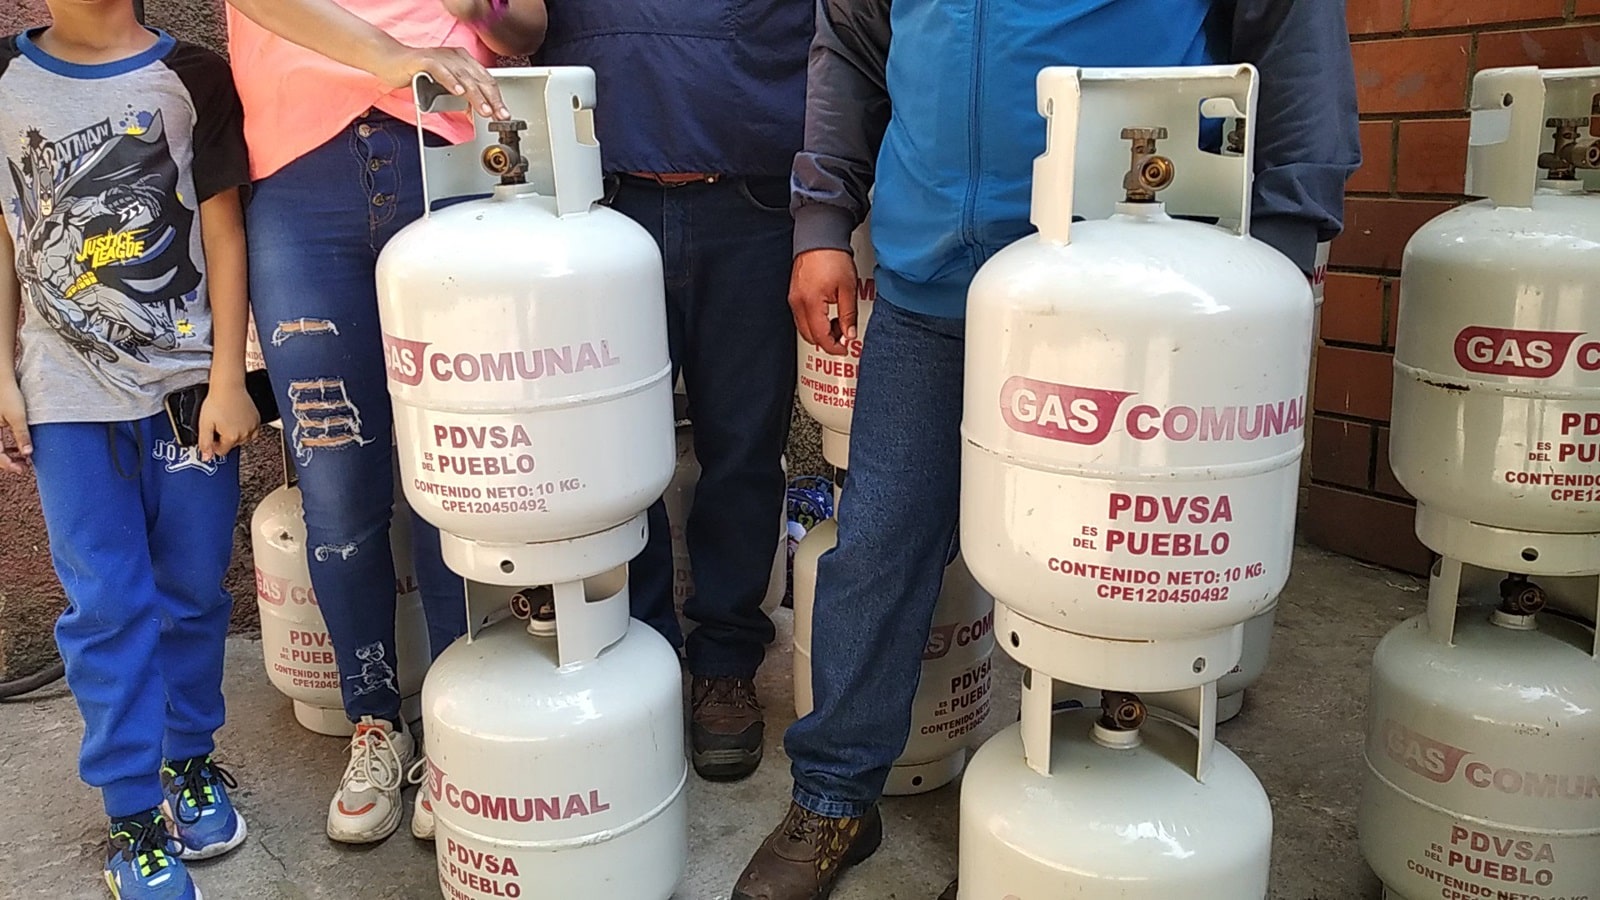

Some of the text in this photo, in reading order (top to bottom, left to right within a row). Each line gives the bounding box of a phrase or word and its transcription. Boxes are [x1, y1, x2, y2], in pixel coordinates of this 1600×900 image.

[76, 230, 138, 262] JUSTICE
[92, 241, 145, 269] LEAGUE
[430, 340, 620, 382] COMUNAL
[1466, 336, 1552, 368] GAS
[801, 376, 839, 395] CONTENIDO
[1011, 388, 1304, 442] GAS COMUNAL
[434, 425, 532, 449] PDVSA
[1537, 442, 1551, 450] ES
[422, 453, 535, 475] ES DEL PUEBLO
[1529, 453, 1550, 461] DEL
[414, 478, 586, 498] CONTENIDO NETO: 10 KG.
[442, 499, 547, 513] CPE120450492
[1108, 493, 1232, 524] PDVSA
[1073, 526, 1229, 556] ES DEL PUEBLO
[1048, 558, 1266, 585] CONTENIDO NETO: 10 KG.
[1097, 584, 1229, 603] CPE120450492
[274, 664, 320, 679] CONTENIDO
[921, 712, 974, 735] CONTENIDO
[1388, 731, 1446, 774] GAS
[446, 783, 610, 822] COMUNAL
[447, 838, 519, 876] PDVSA
[1451, 826, 1555, 863] PDVSA
[1407, 859, 1491, 897] CONTENIDO
[1425, 843, 1553, 886] ES DEL PUEBLO
[449, 862, 520, 898] PUEBLO
